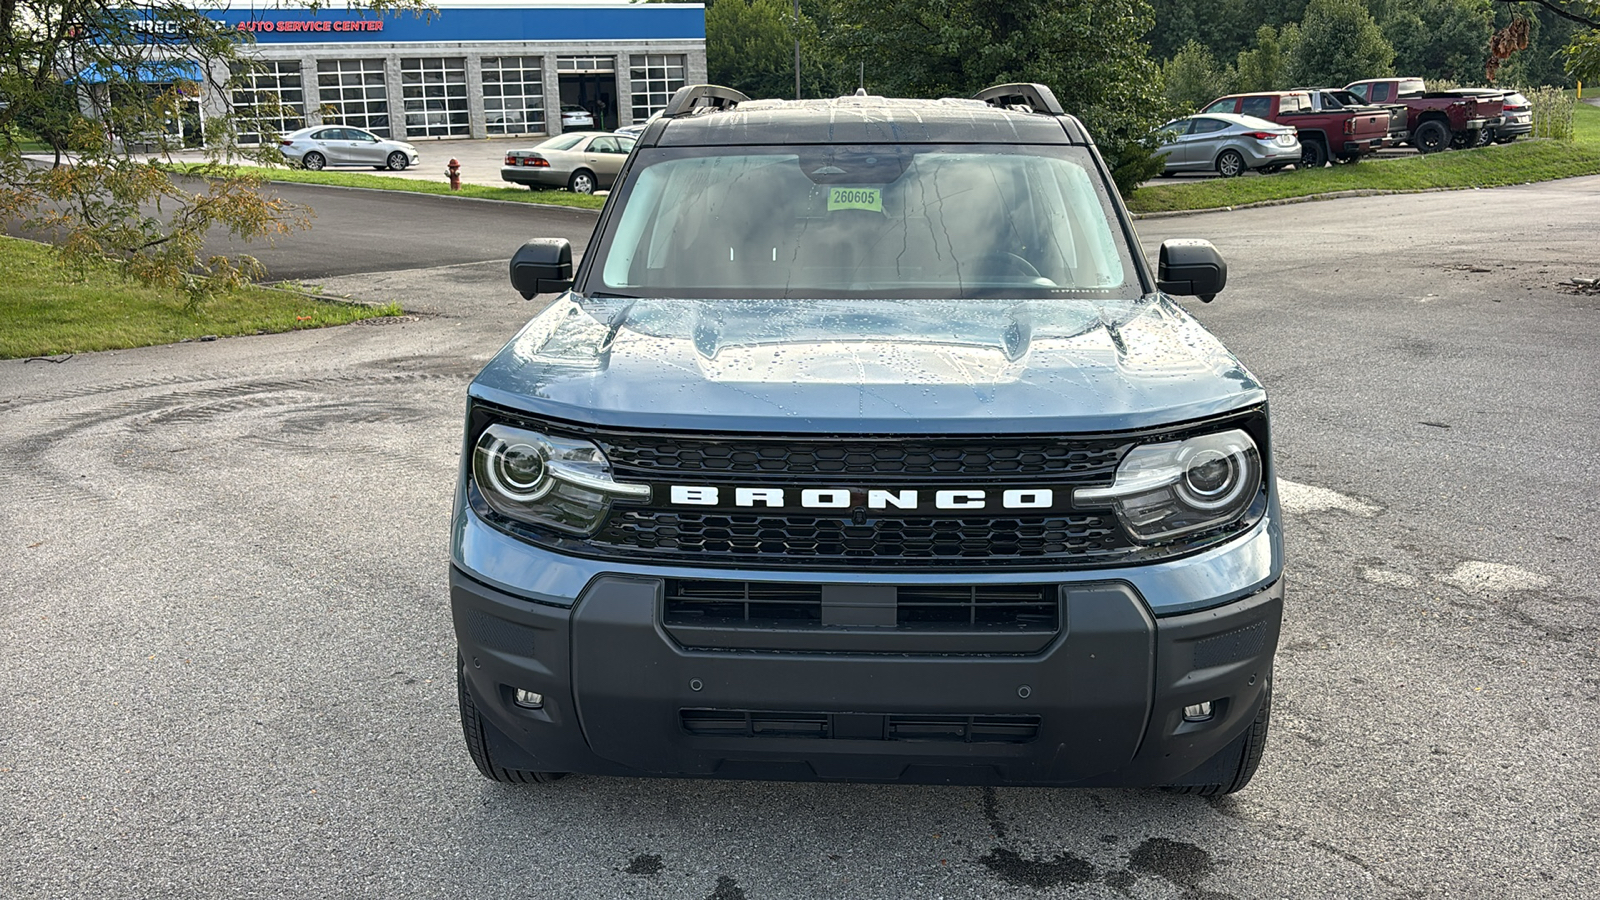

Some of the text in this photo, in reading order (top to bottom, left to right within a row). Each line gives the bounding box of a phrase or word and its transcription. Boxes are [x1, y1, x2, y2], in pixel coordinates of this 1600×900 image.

[128, 19, 384, 34] TIRECE AUTO SERVICE CENTER
[833, 190, 875, 205] 260605
[670, 485, 1053, 509] BRONCO
